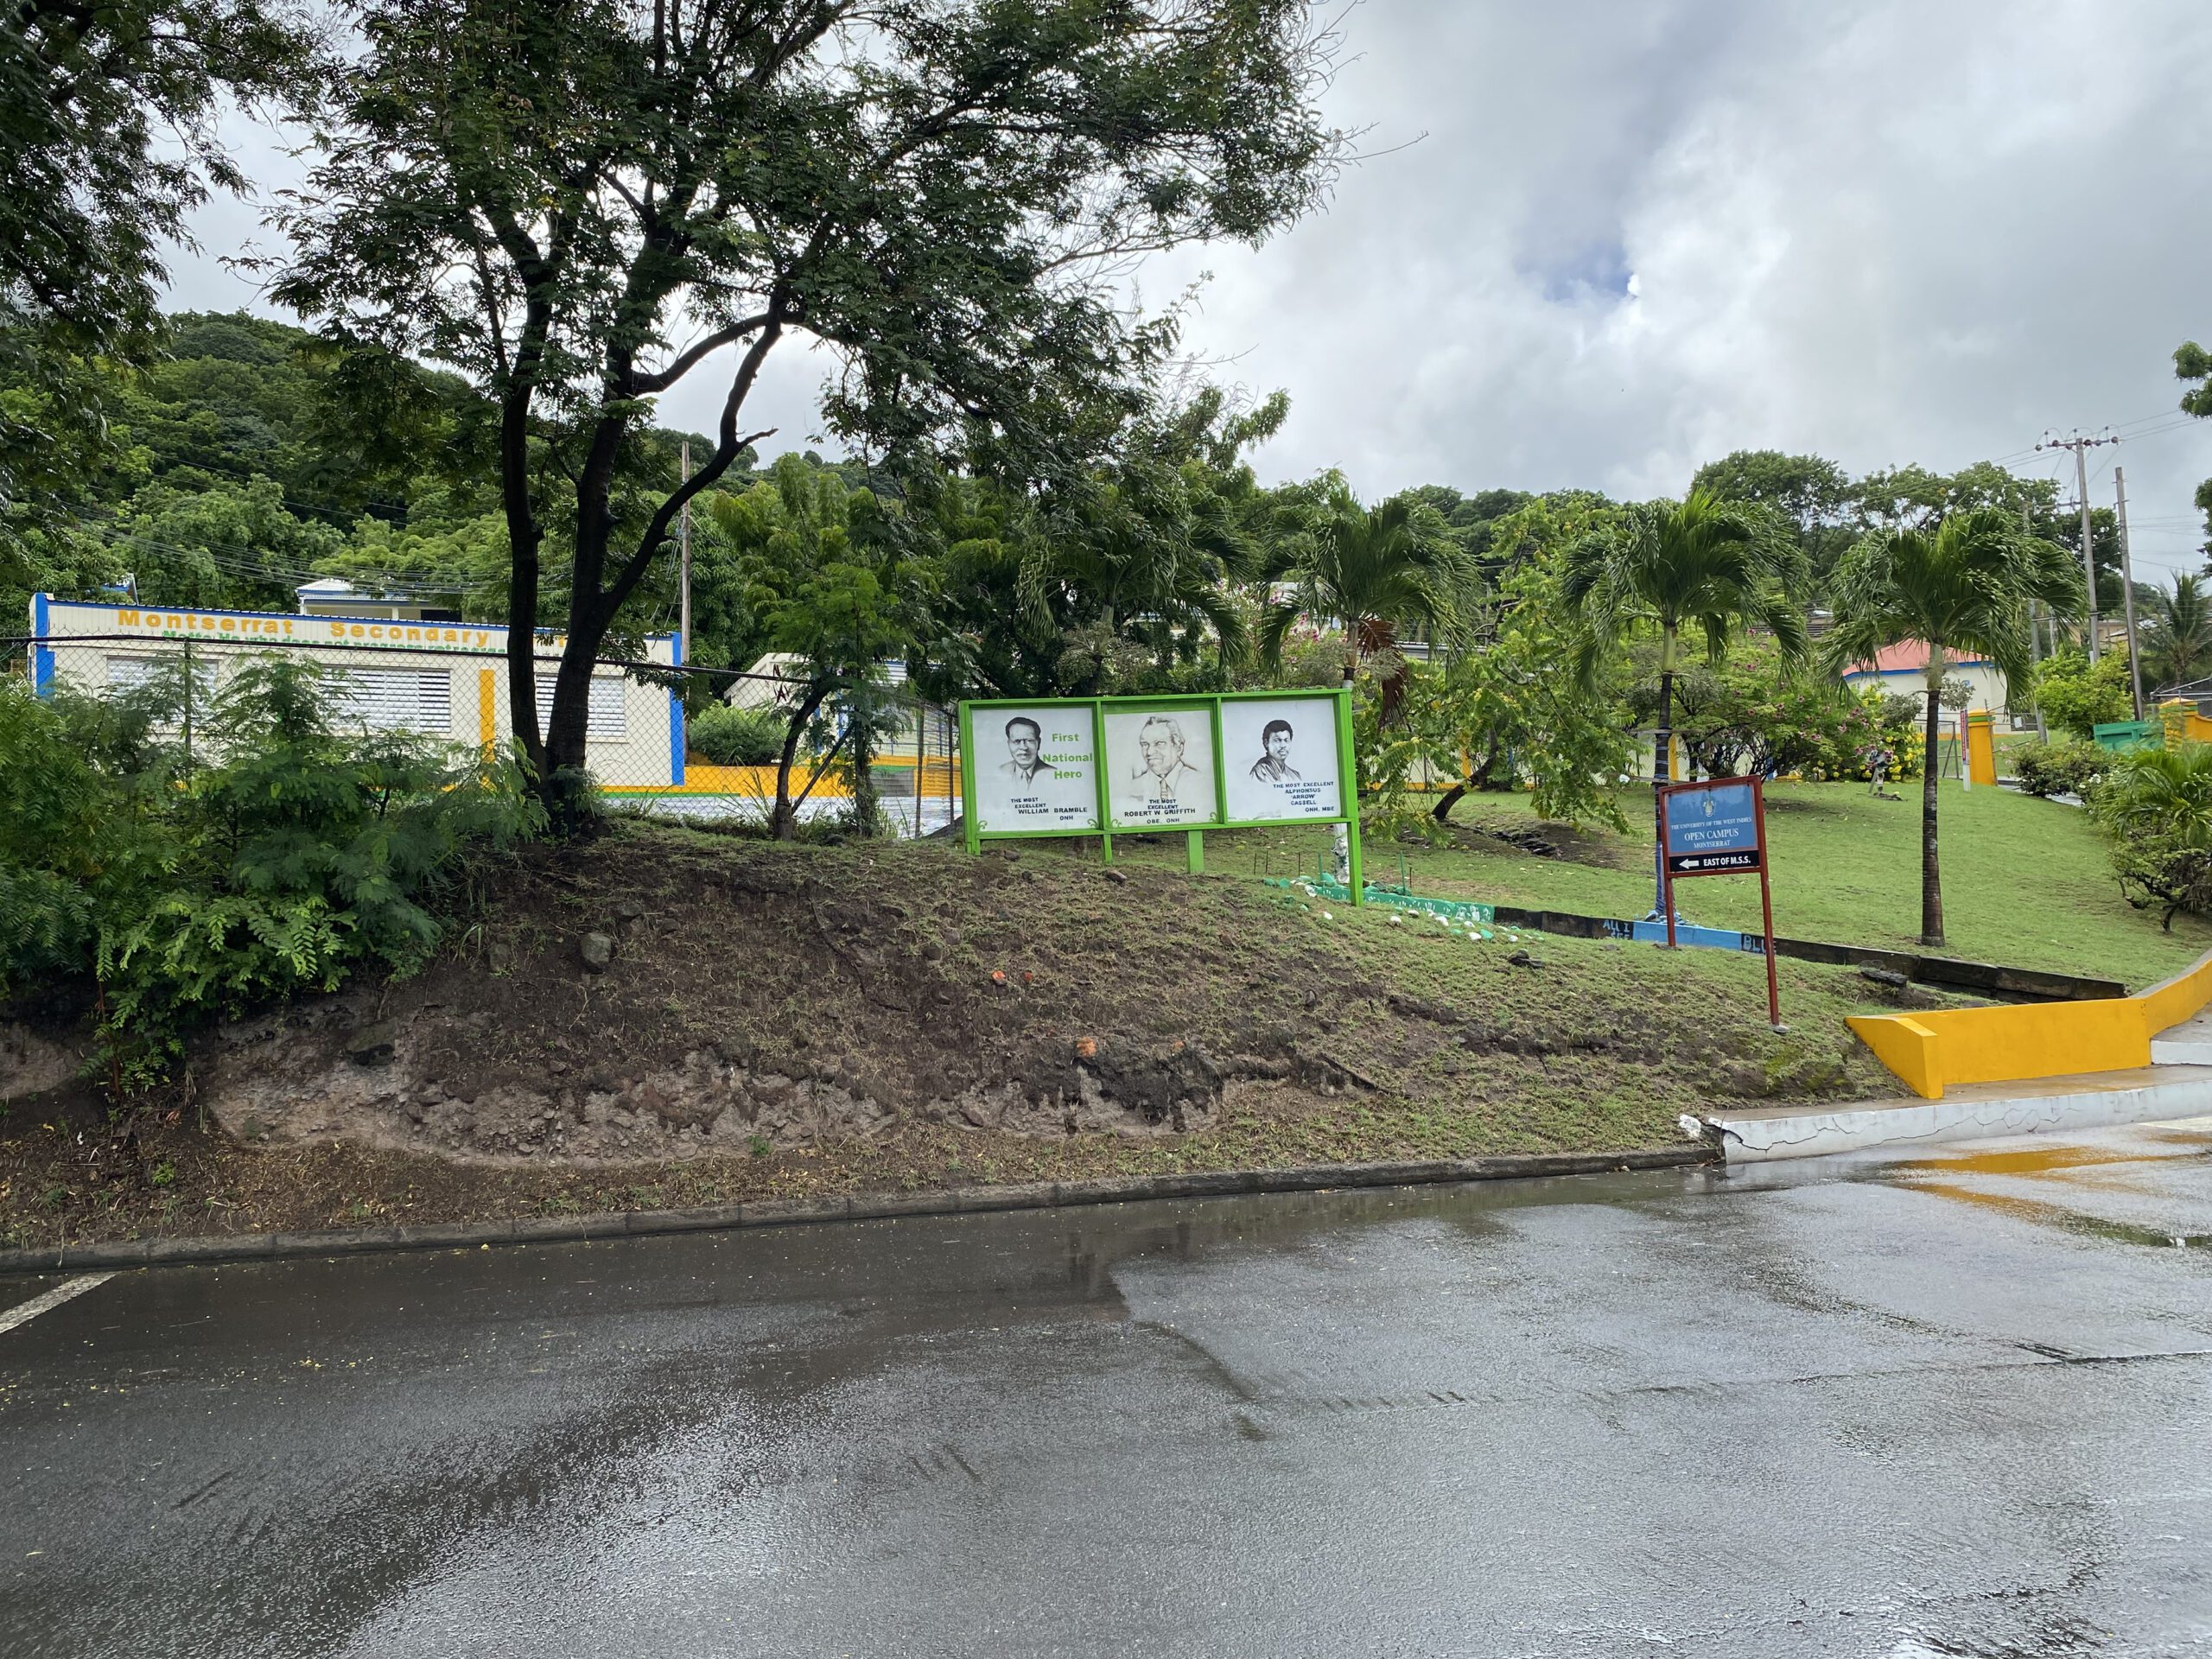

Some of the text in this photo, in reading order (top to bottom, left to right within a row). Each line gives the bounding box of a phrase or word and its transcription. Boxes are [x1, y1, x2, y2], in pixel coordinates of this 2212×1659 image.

[118, 609, 489, 648] Montserrat Secondary
[1052, 734, 1079, 742] First
[1042, 753, 1093, 762] National
[1054, 770, 1083, 779] Hero
[1684, 828, 1739, 841] OPEN CAMPUS
[1694, 840, 1731, 849] MONTSERRAT
[1703, 858, 1719, 867] EAST
[1731, 855, 1751, 865] M.S.S.
[1603, 918, 1620, 931] ALL
